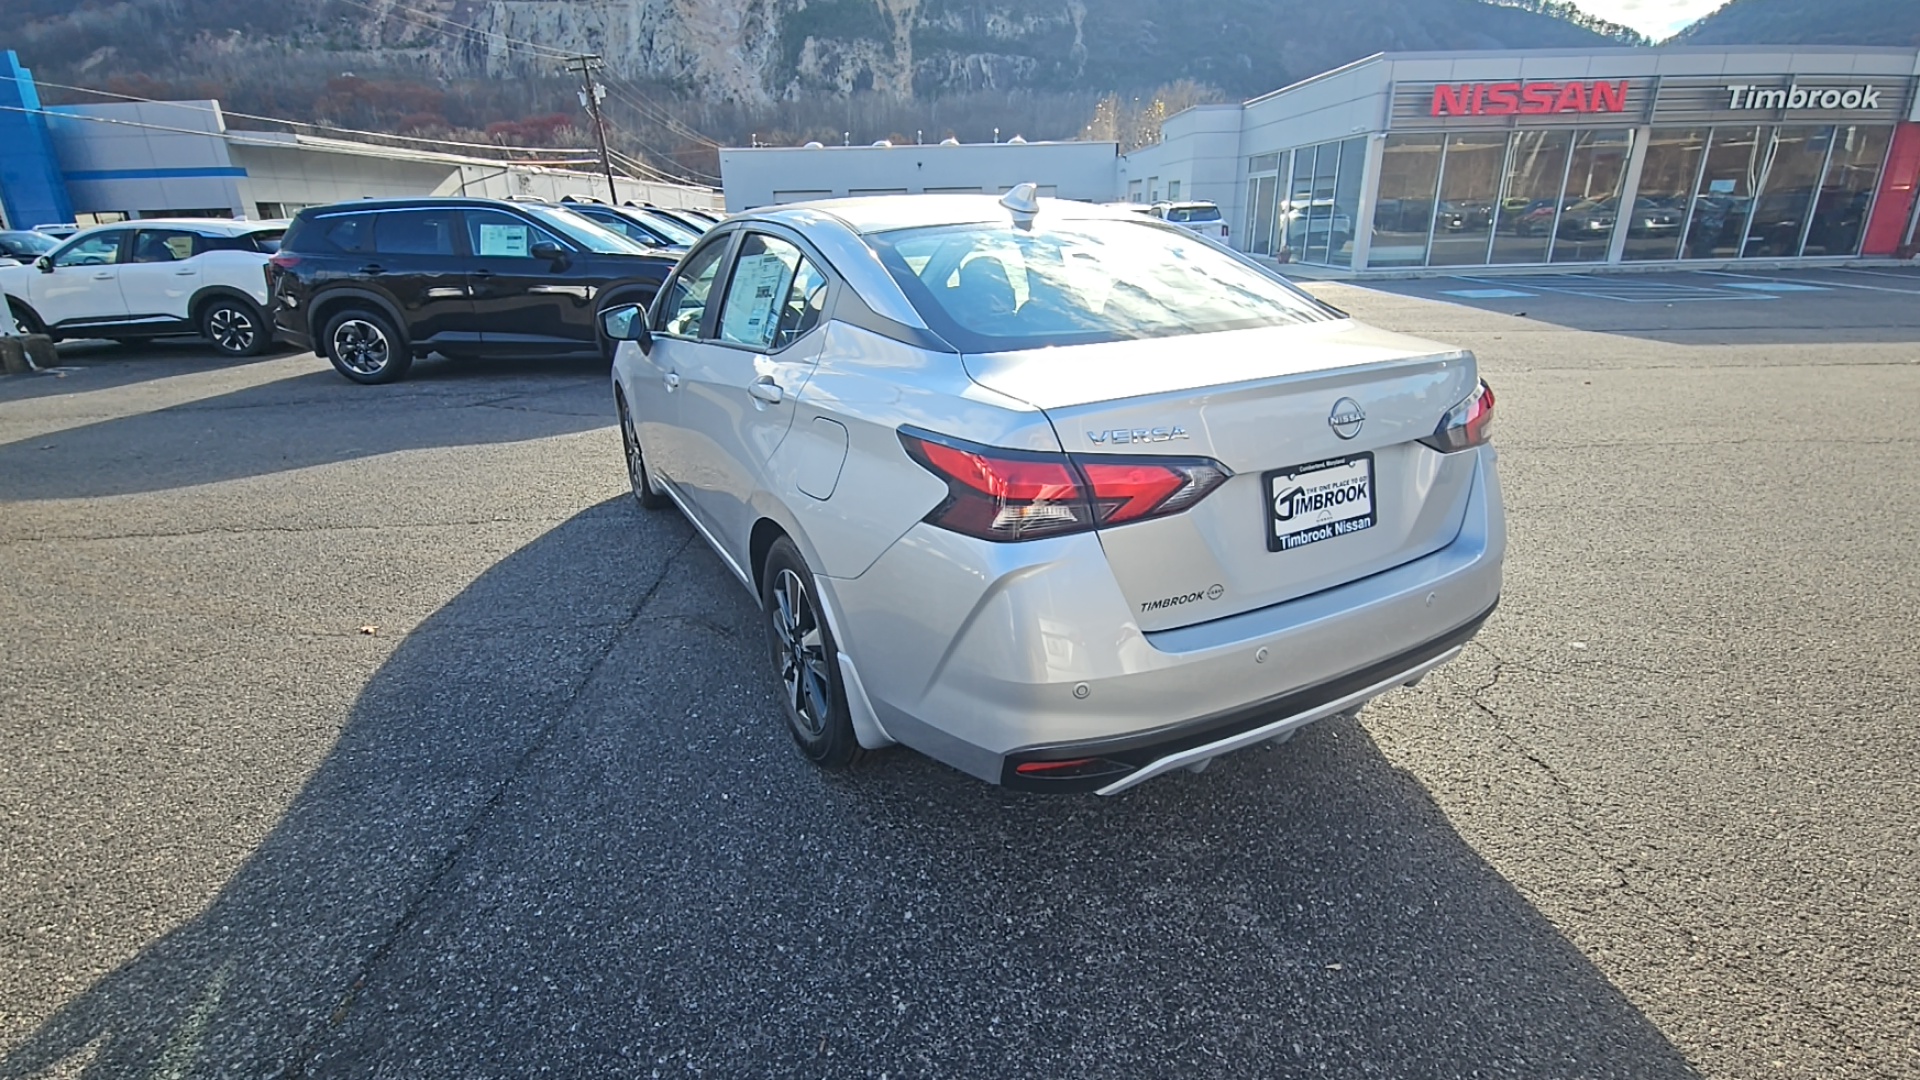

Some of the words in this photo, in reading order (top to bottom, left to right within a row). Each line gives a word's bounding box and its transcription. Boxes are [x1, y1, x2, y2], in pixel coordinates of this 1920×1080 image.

[1431, 80, 1629, 117] NISSAN
[1727, 84, 1881, 110] Timbrook
[1087, 426, 1190, 446] VERSA
[1306, 486, 1318, 495] THE
[1319, 483, 1331, 492] ONE
[1332, 479, 1350, 489] PLACE
[1274, 482, 1368, 521] TIMBROOK
[1280, 524, 1334, 550] Timbrook
[1334, 517, 1371, 535] Nissan
[1141, 591, 1205, 613] TIMBROOK
